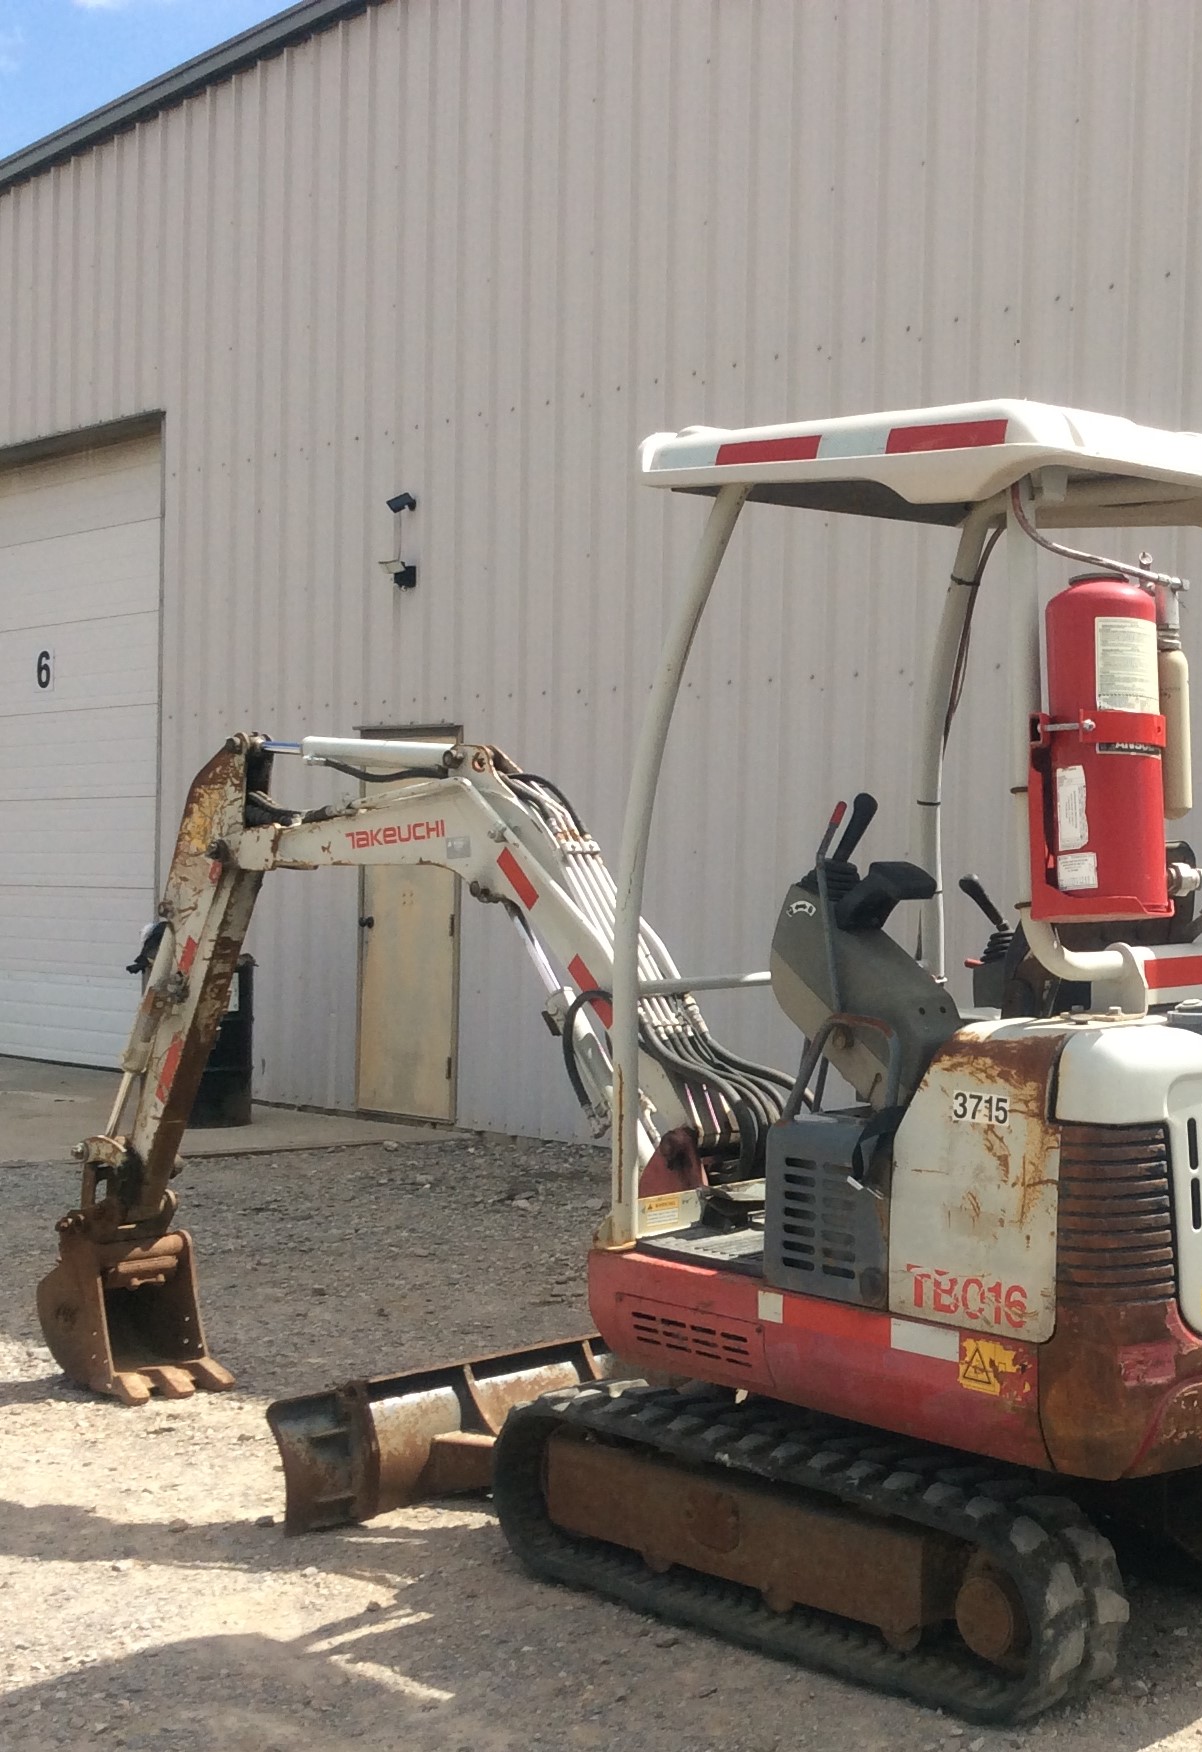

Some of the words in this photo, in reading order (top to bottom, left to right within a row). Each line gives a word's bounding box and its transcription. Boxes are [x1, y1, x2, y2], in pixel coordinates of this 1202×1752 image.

[37, 650, 51, 689] 6
[953, 1091, 1008, 1125] 3715
[906, 1263, 1028, 1329] TB016
